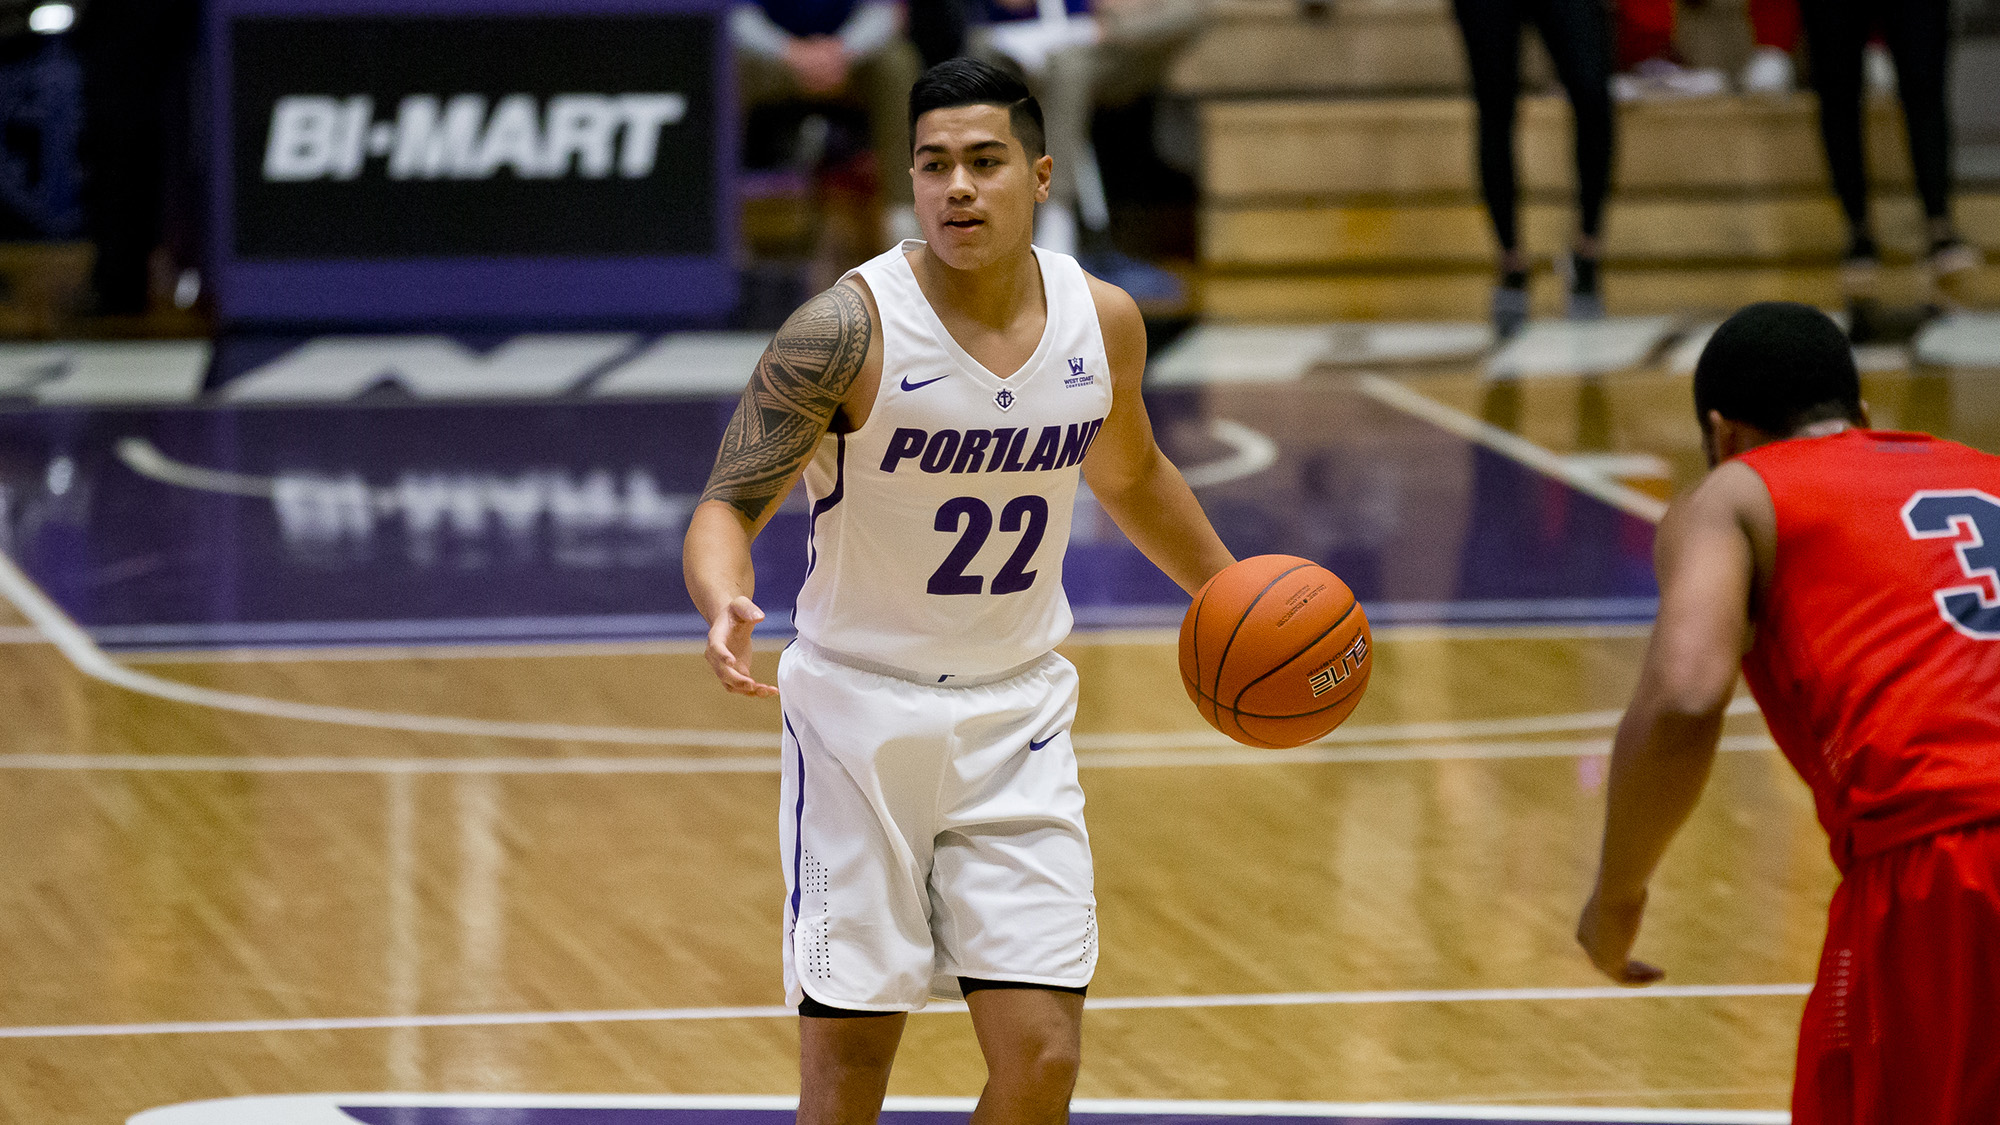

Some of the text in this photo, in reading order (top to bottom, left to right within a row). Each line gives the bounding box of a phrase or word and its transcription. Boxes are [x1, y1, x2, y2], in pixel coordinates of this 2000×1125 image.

[1079, 375, 1094, 383] COAST
[879, 417, 1104, 474] PORTLAND
[926, 495, 1049, 595] 22
[1308, 634, 1370, 698] ELITE
